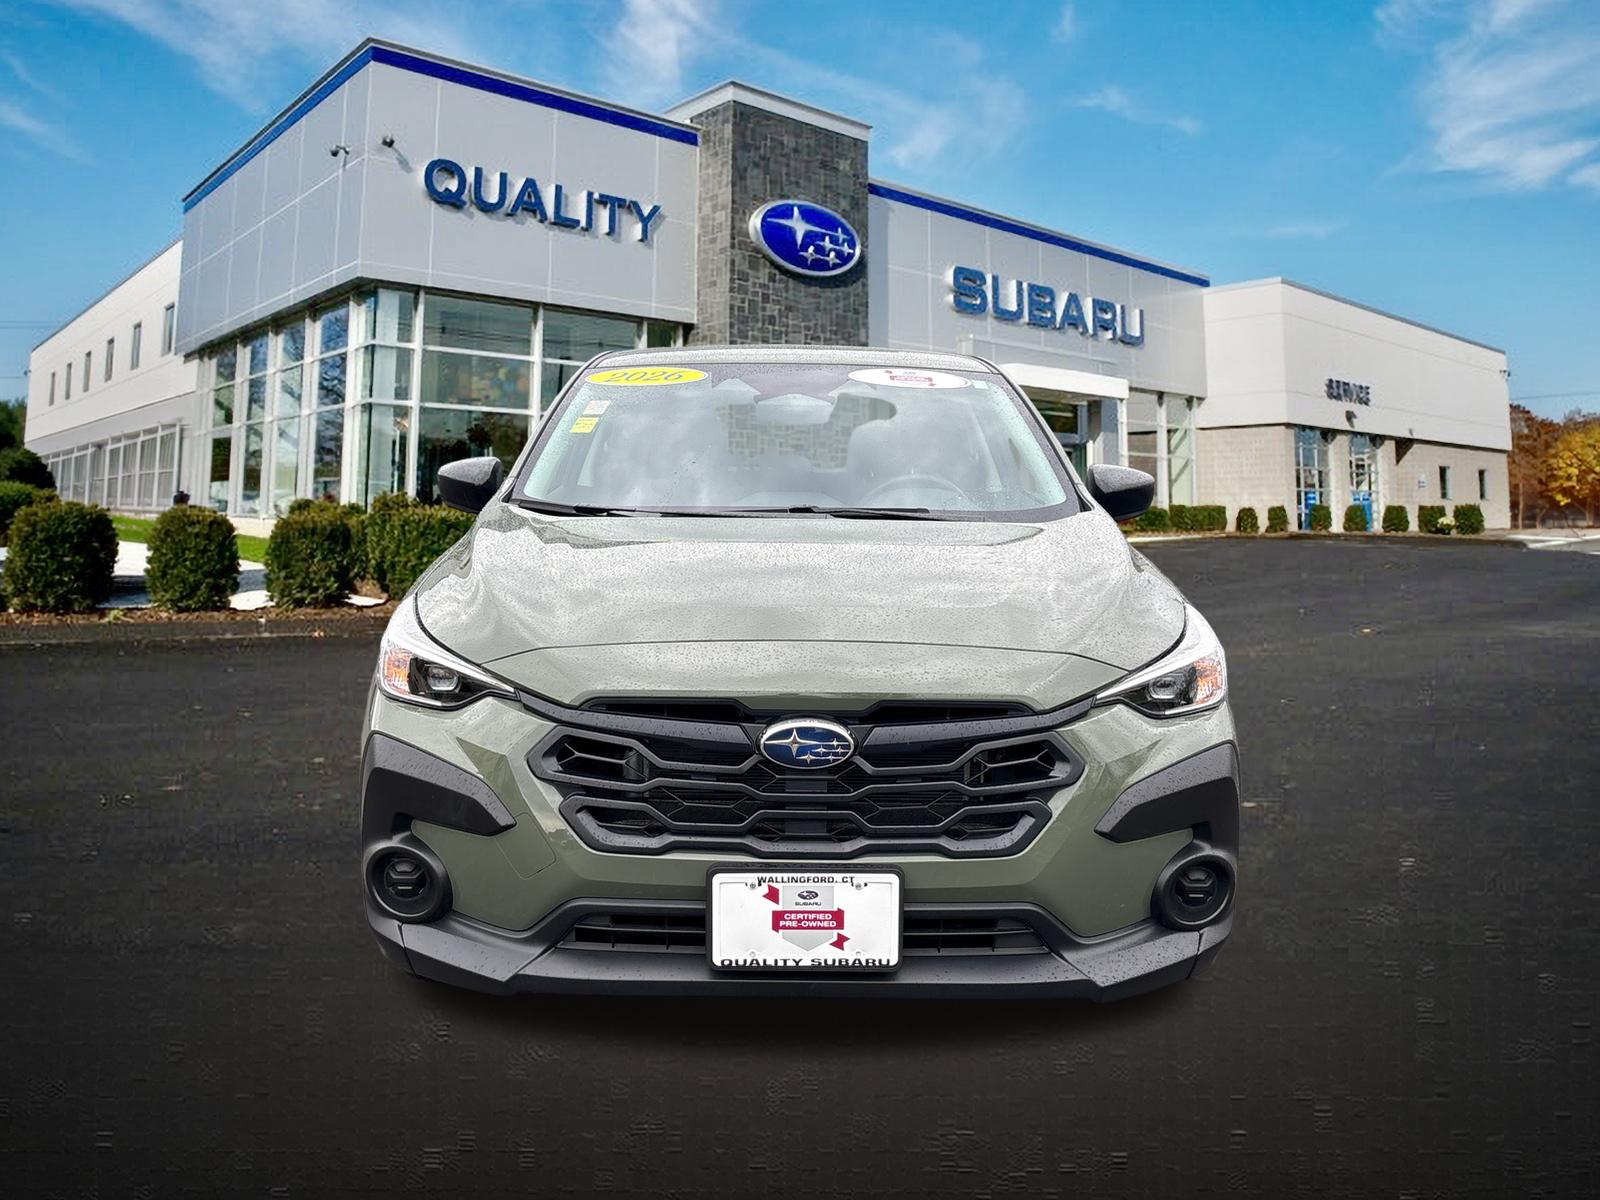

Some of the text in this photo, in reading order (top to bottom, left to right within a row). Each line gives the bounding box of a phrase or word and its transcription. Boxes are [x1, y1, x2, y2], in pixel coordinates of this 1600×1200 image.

[424, 158, 662, 242] QUALITY
[951, 265, 1145, 347] SUBARU
[606, 370, 684, 383] 2026
[1325, 378, 1371, 406] SERVICE
[841, 876, 855, 884] CT
[720, 958, 891, 967] QUALITY SUBARU
